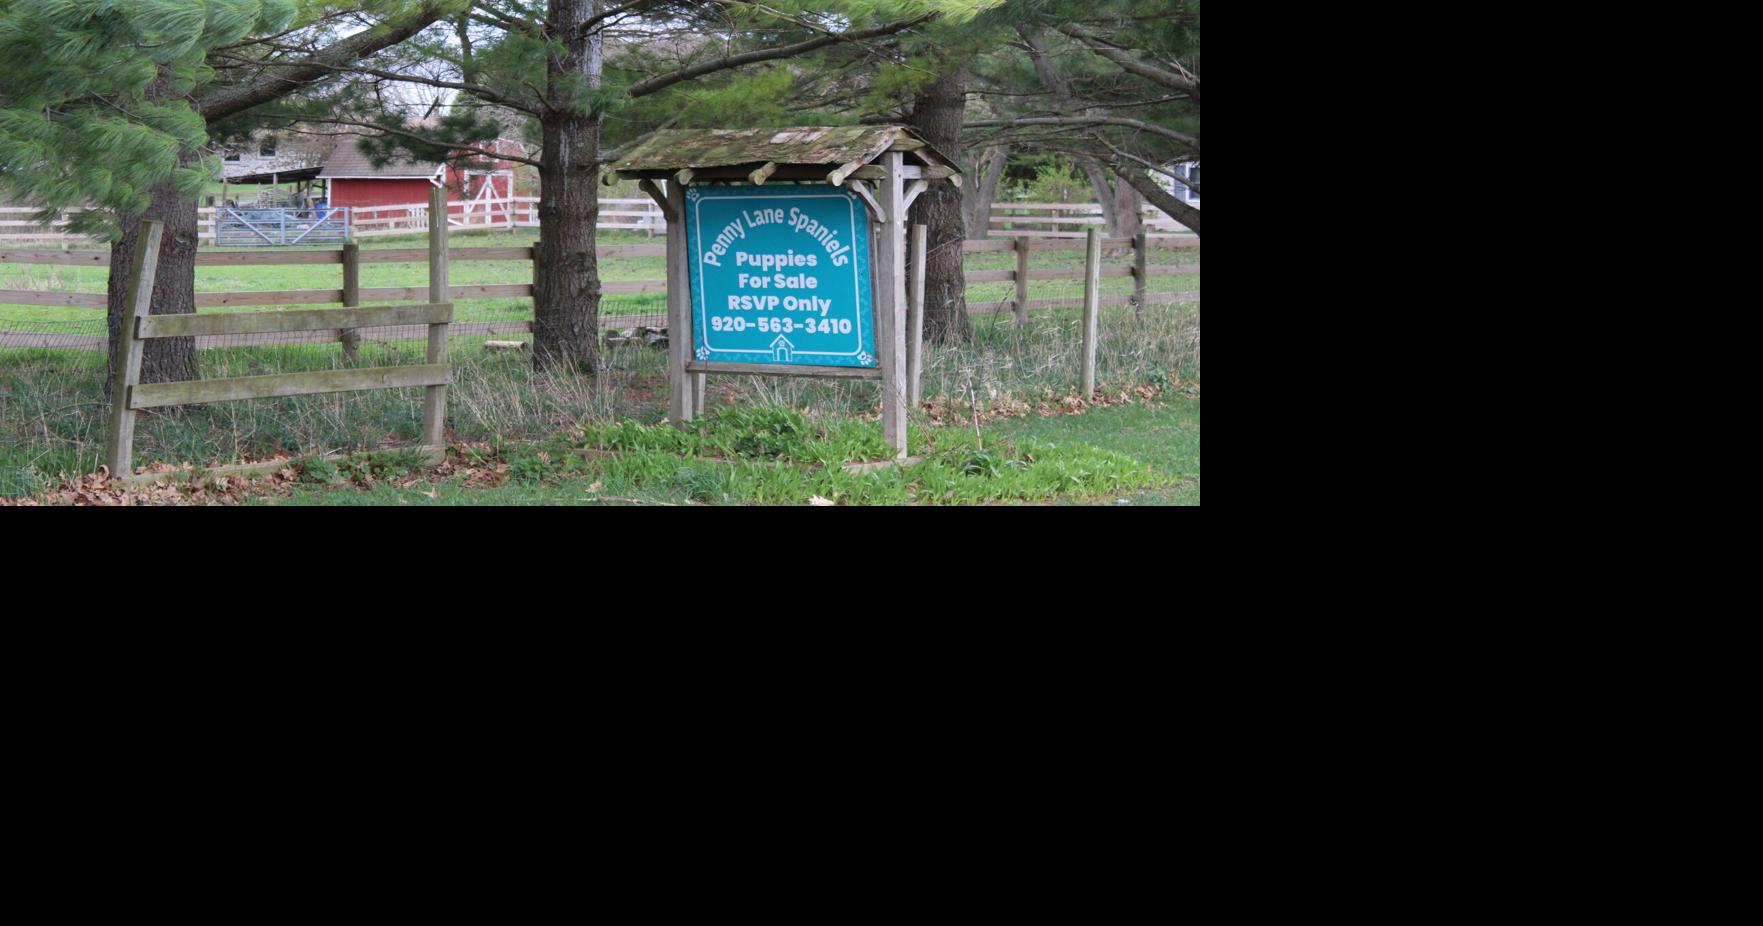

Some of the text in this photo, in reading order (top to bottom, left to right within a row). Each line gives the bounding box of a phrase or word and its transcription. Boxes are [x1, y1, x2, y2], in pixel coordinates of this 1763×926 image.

[703, 207, 851, 267] Penny Lane Spaniels
[735, 249, 817, 271] Puppies
[738, 273, 817, 289] For Sale
[727, 295, 832, 317] RSVP Only
[711, 316, 852, 334] 920-563-3410
